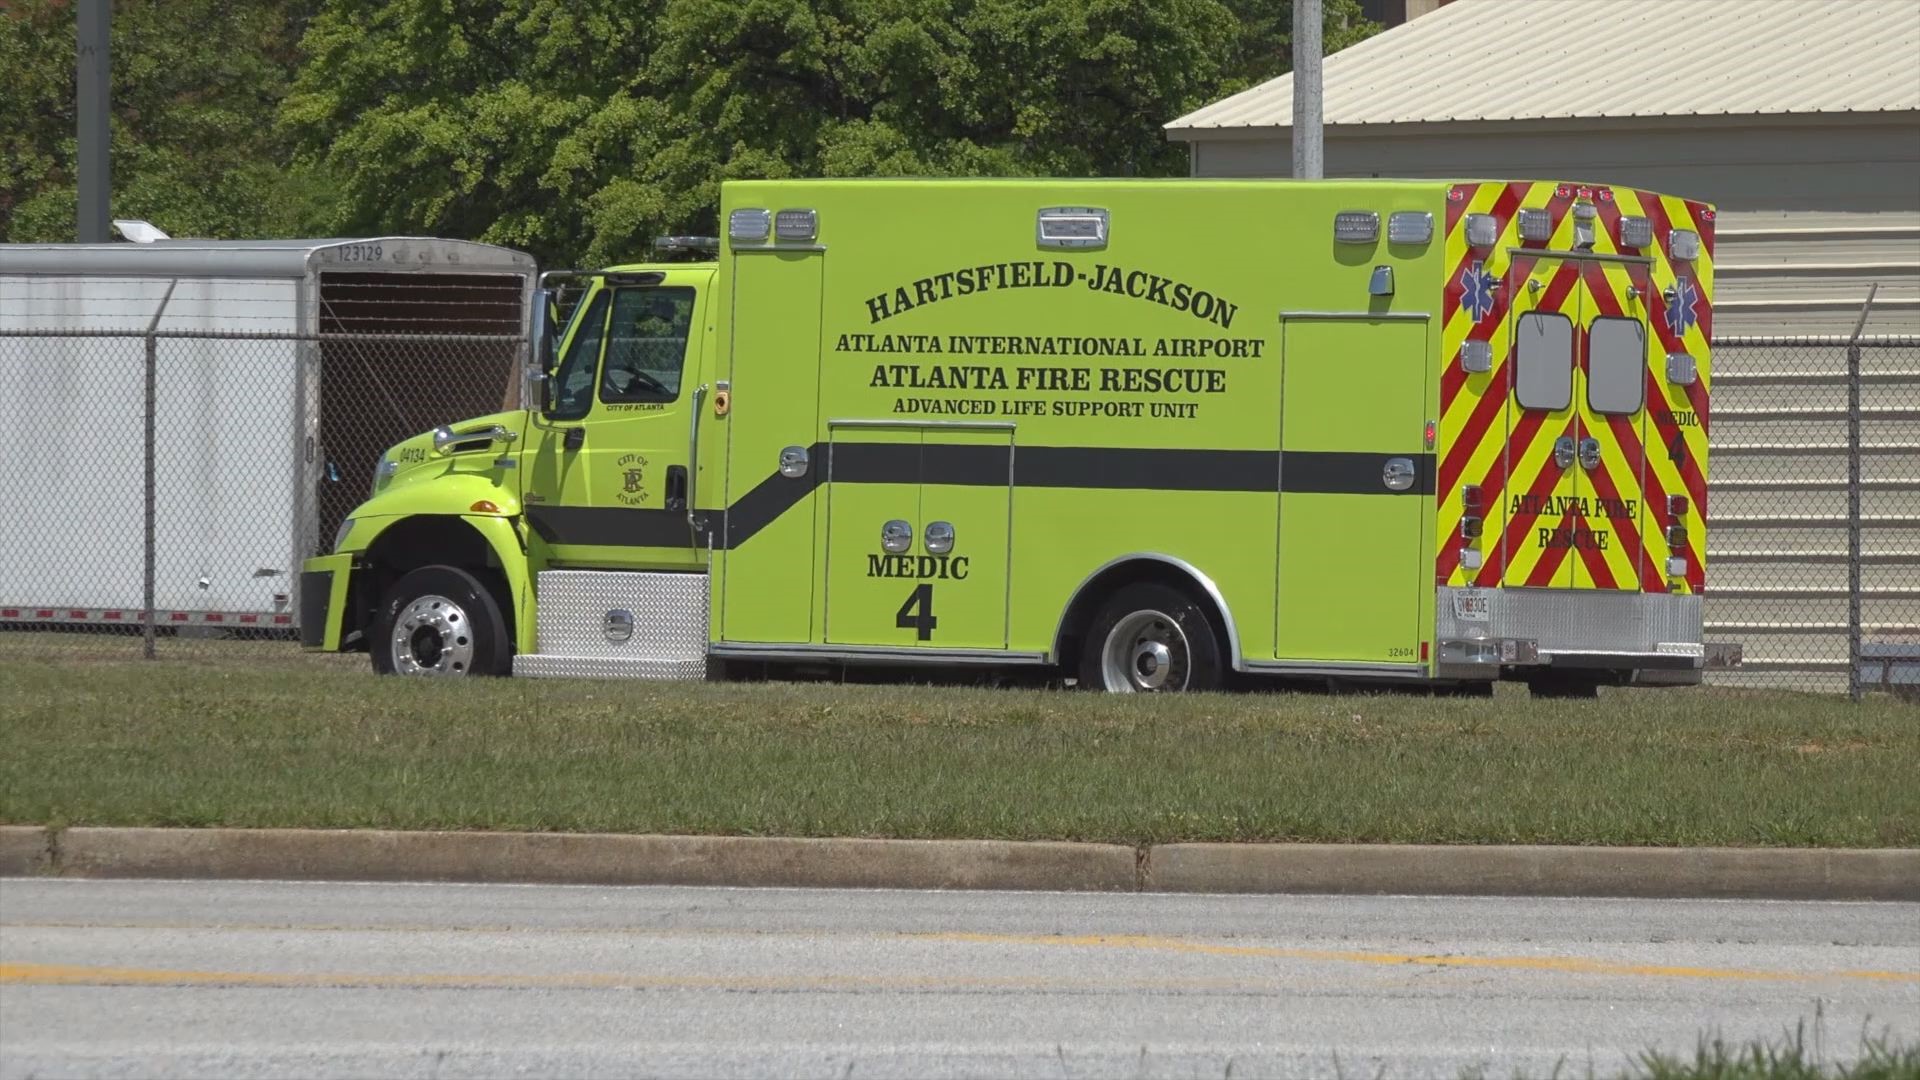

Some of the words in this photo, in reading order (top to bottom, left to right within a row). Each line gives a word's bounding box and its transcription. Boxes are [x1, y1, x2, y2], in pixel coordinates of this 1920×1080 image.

[338, 246, 383, 262] 123129
[865, 261, 1238, 329] HARTSFIELD-JACKSON
[835, 334, 943, 353] ATLANTA
[948, 336, 1147, 356] INTERNATIONAL
[1152, 338, 1265, 358] AIRPORT
[869, 365, 1009, 389] ATLANTA
[1016, 367, 1090, 391] FIRE
[1099, 368, 1226, 393] RESCUE
[892, 398, 996, 415] ADVANCED
[1001, 400, 1047, 416] LIFE
[1052, 401, 1144, 418] SUPPORT
[1150, 402, 1199, 419] UNIT
[1657, 410, 1700, 427] MEDIC
[400, 447, 425, 463] 04134
[617, 453, 635, 467] CITY
[636, 455, 649, 467] OF
[1668, 430, 1686, 470] 4
[616, 492, 649, 506] ATLANTA
[1510, 494, 1591, 518] ATLANTA
[1594, 498, 1637, 519] FIRE
[1538, 527, 1609, 551] RESCUE
[867, 553, 969, 580] MEDIC
[896, 583, 937, 641] 4
[1388, 647, 1414, 657] 32604
